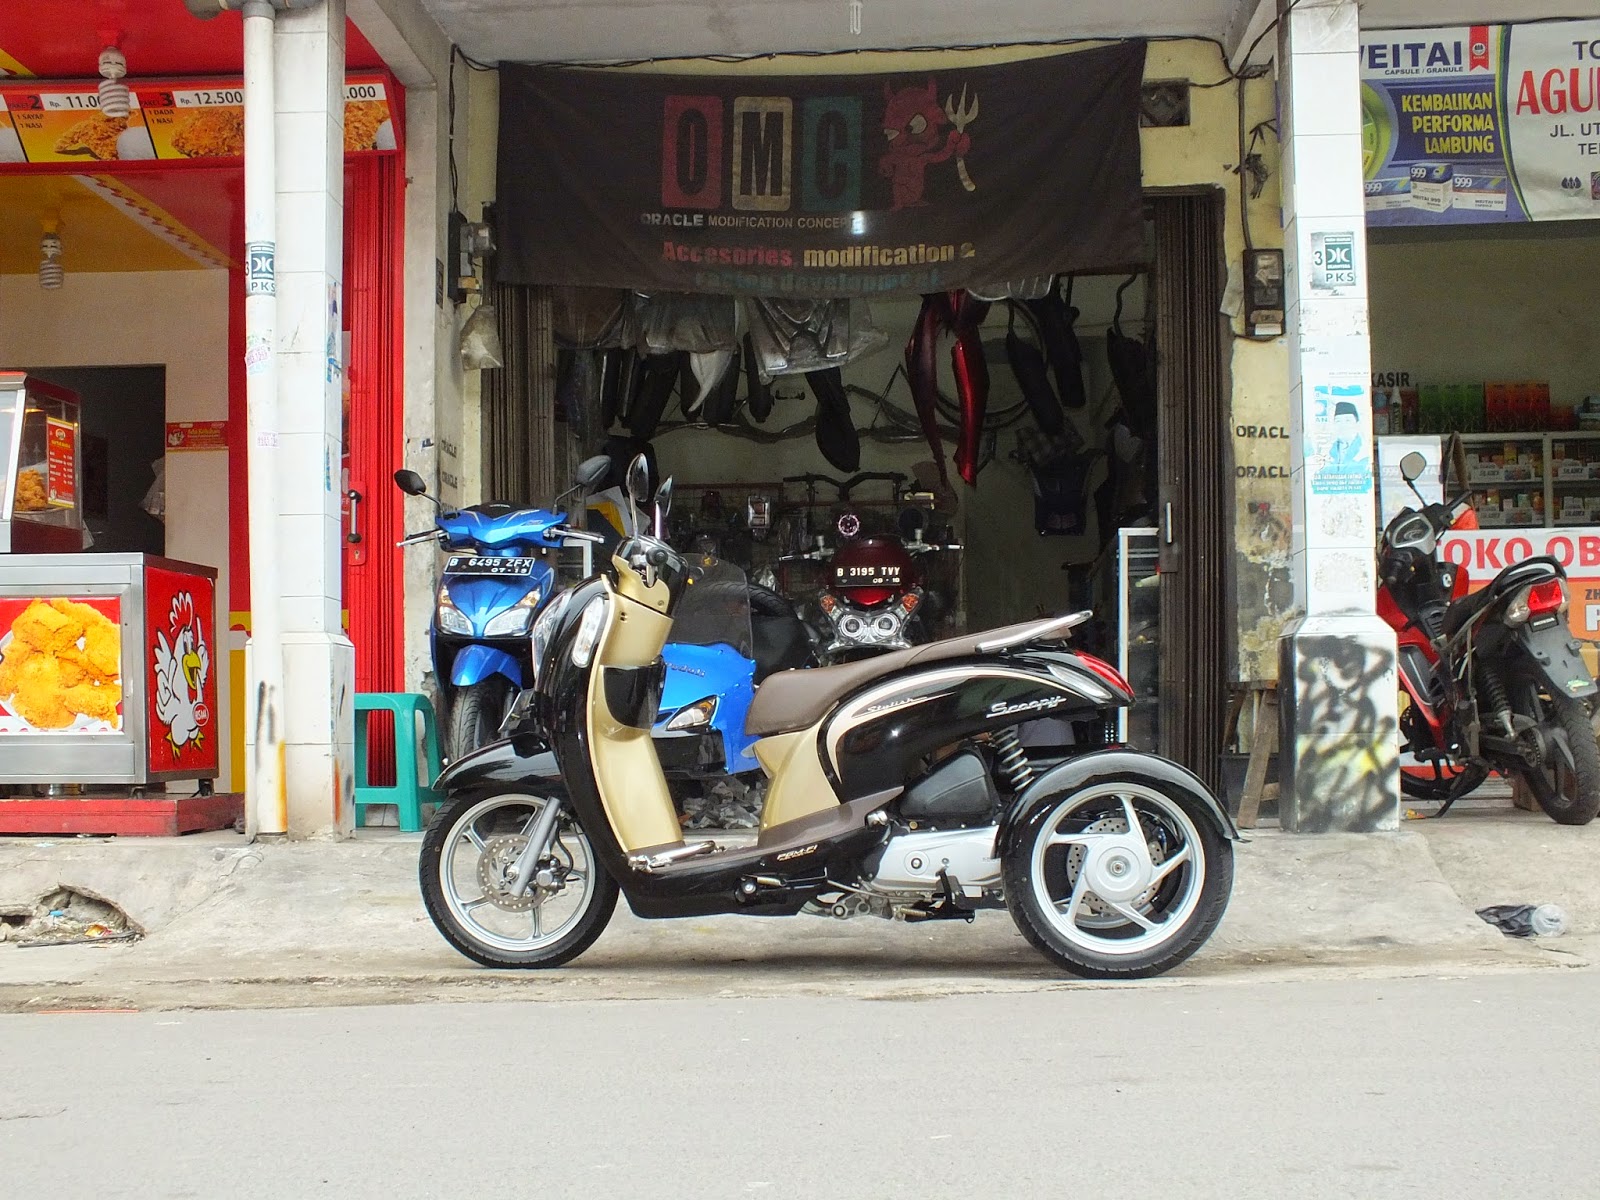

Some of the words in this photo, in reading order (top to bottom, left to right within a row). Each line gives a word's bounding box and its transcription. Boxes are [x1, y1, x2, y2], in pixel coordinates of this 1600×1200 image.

[1360, 41, 1462, 69] EITAI
[1384, 68, 1421, 76] CAPSULE
[1426, 66, 1464, 74] GRANULE
[194, 90, 243, 105] 12.500
[346, 85, 376, 99] .000
[1515, 66, 1600, 116] AGU
[27, 95, 41, 110] 2
[49, 101, 61, 109] Rp.
[65, 95, 101, 109] 11.0
[160, 92, 173, 107] 3
[1401, 91, 1493, 113] KEMBALIKAN
[1412, 113, 1495, 133] PERFORMA
[1550, 124, 1575, 138] JL.
[1424, 134, 1495, 154] LAMBUNG
[1578, 142, 1600, 156] TE
[673, 105, 851, 199] OMC
[1410, 166, 1427, 179] 999
[1364, 182, 1383, 193] 999
[1454, 177, 1473, 188] 999
[640, 213, 704, 227] ORACLE
[707, 214, 794, 229] MODIFICATION
[797, 216, 850, 230] CONCEP
[803, 243, 956, 268] modification
[1314, 250, 1323, 266] 3
[1325, 272, 1355, 283] PKS
[251, 281, 276, 293] PKS
[1235, 465, 1292, 479] ORACL
[1436, 537, 1533, 570] OKO
[449, 558, 459, 567] B
[468, 558, 502, 567] 6495
[505, 559, 532, 568] ZFX
[836, 567, 844, 577] B
[849, 566, 876, 577] 3195
[880, 566, 901, 576] TVY
[867, 697, 916, 712] Stylish
[986, 695, 1067, 719] Scoopy
